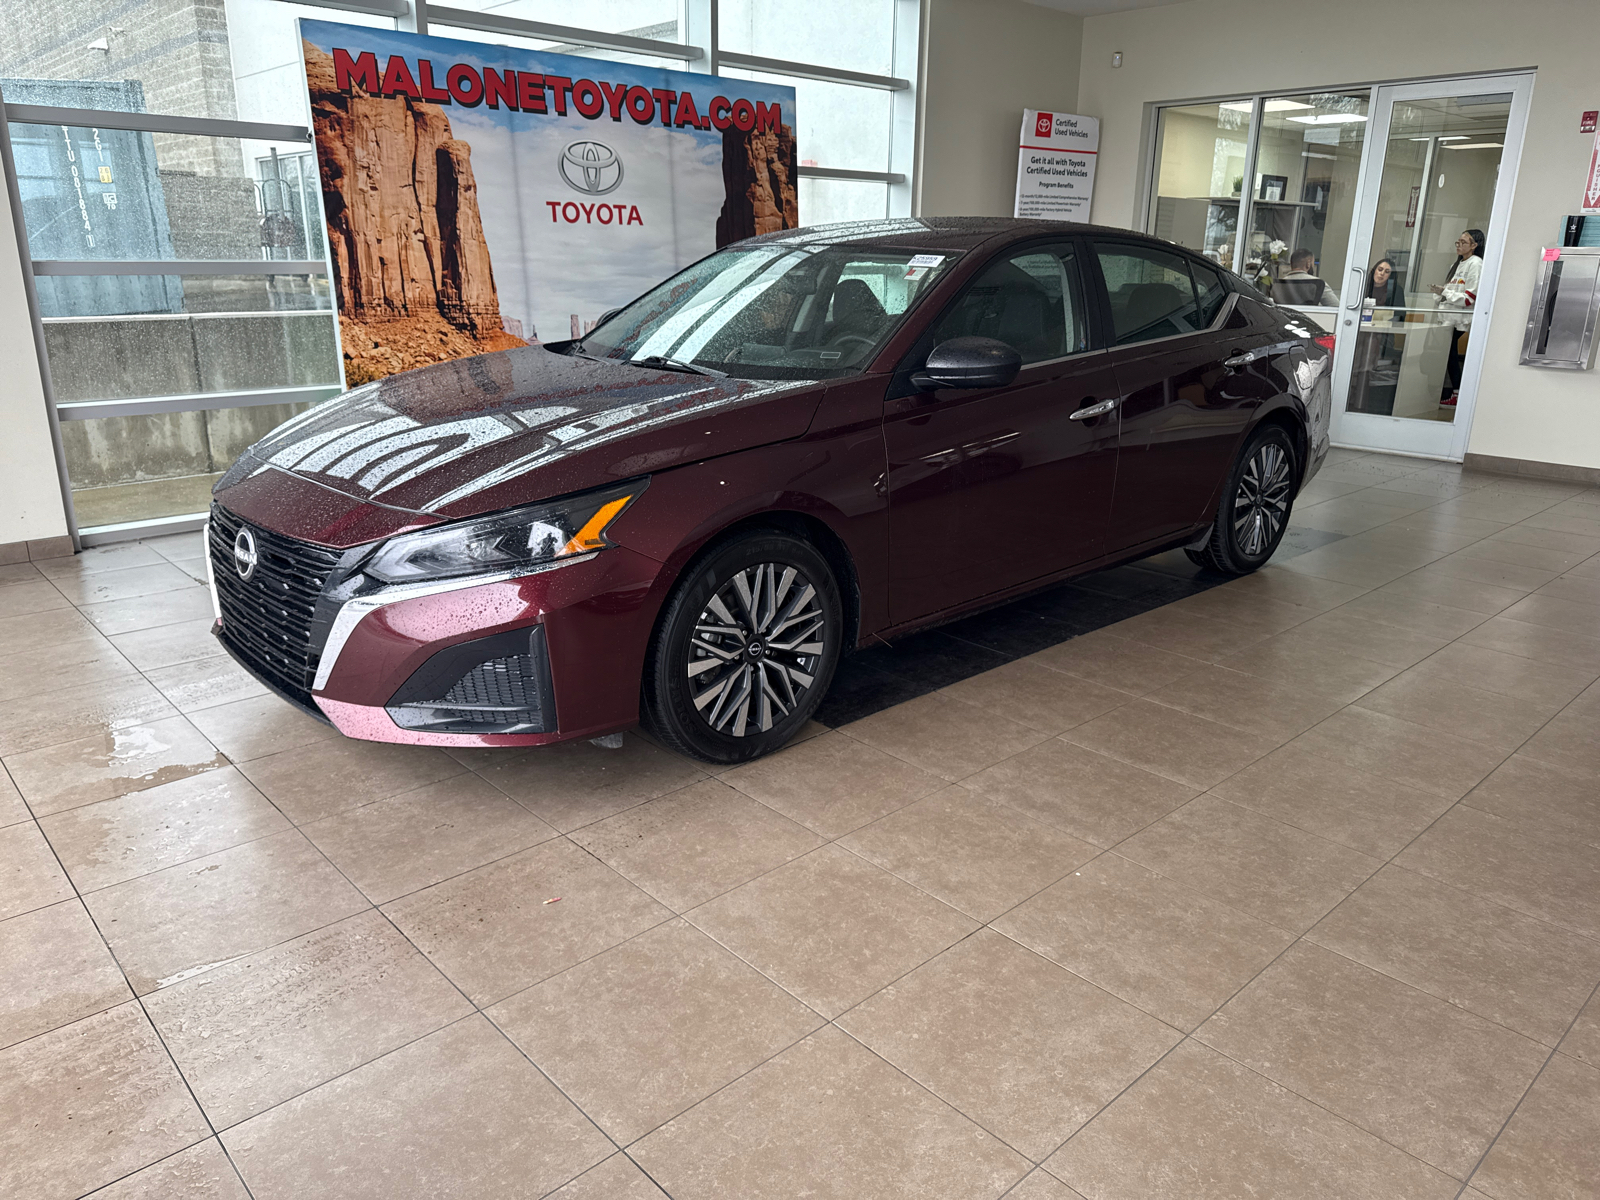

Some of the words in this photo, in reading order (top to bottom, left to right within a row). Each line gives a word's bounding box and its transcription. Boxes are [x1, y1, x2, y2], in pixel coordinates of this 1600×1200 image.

[334, 49, 782, 134] MALONETOYOTA.COM
[1056, 119, 1077, 127] Certified
[1055, 128, 1068, 136] Used
[1068, 129, 1088, 138] Vehicles
[1031, 156, 1042, 164] Get
[1042, 157, 1046, 165] it
[1055, 158, 1068, 166] with
[1068, 159, 1086, 169] Toyota
[1027, 167, 1051, 175] Certified
[1052, 168, 1066, 176] Used
[1067, 169, 1088, 177] Vehicles
[1039, 181, 1057, 189] Program
[546, 201, 643, 225] TOYOTA
